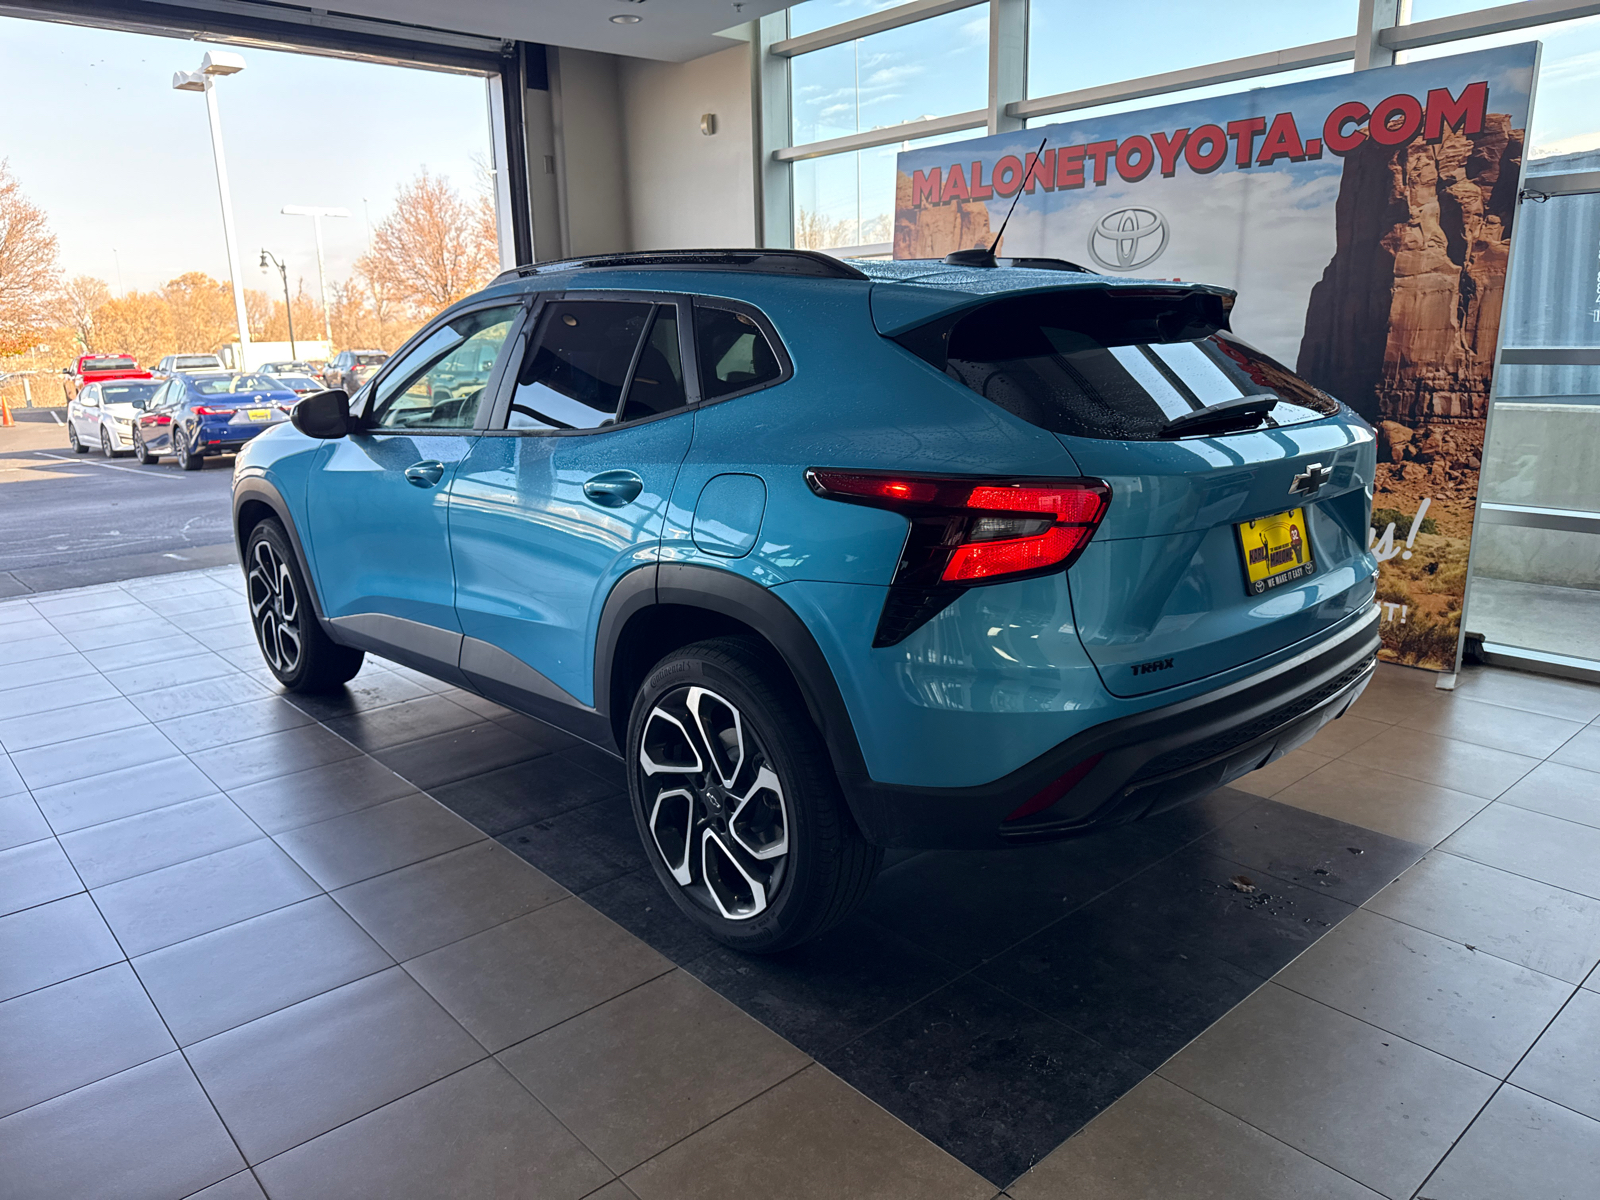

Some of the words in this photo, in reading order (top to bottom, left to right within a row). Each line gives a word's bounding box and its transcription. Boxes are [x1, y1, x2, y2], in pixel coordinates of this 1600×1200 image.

[912, 81, 1489, 205] MALONETOYOTA.COM
[1267, 579, 1275, 588] WE
[1276, 573, 1288, 585] MAKE
[1288, 571, 1292, 580] IT
[1292, 567, 1303, 579] EASY
[650, 661, 685, 689] Continental
[1131, 657, 1174, 676] TRAX
